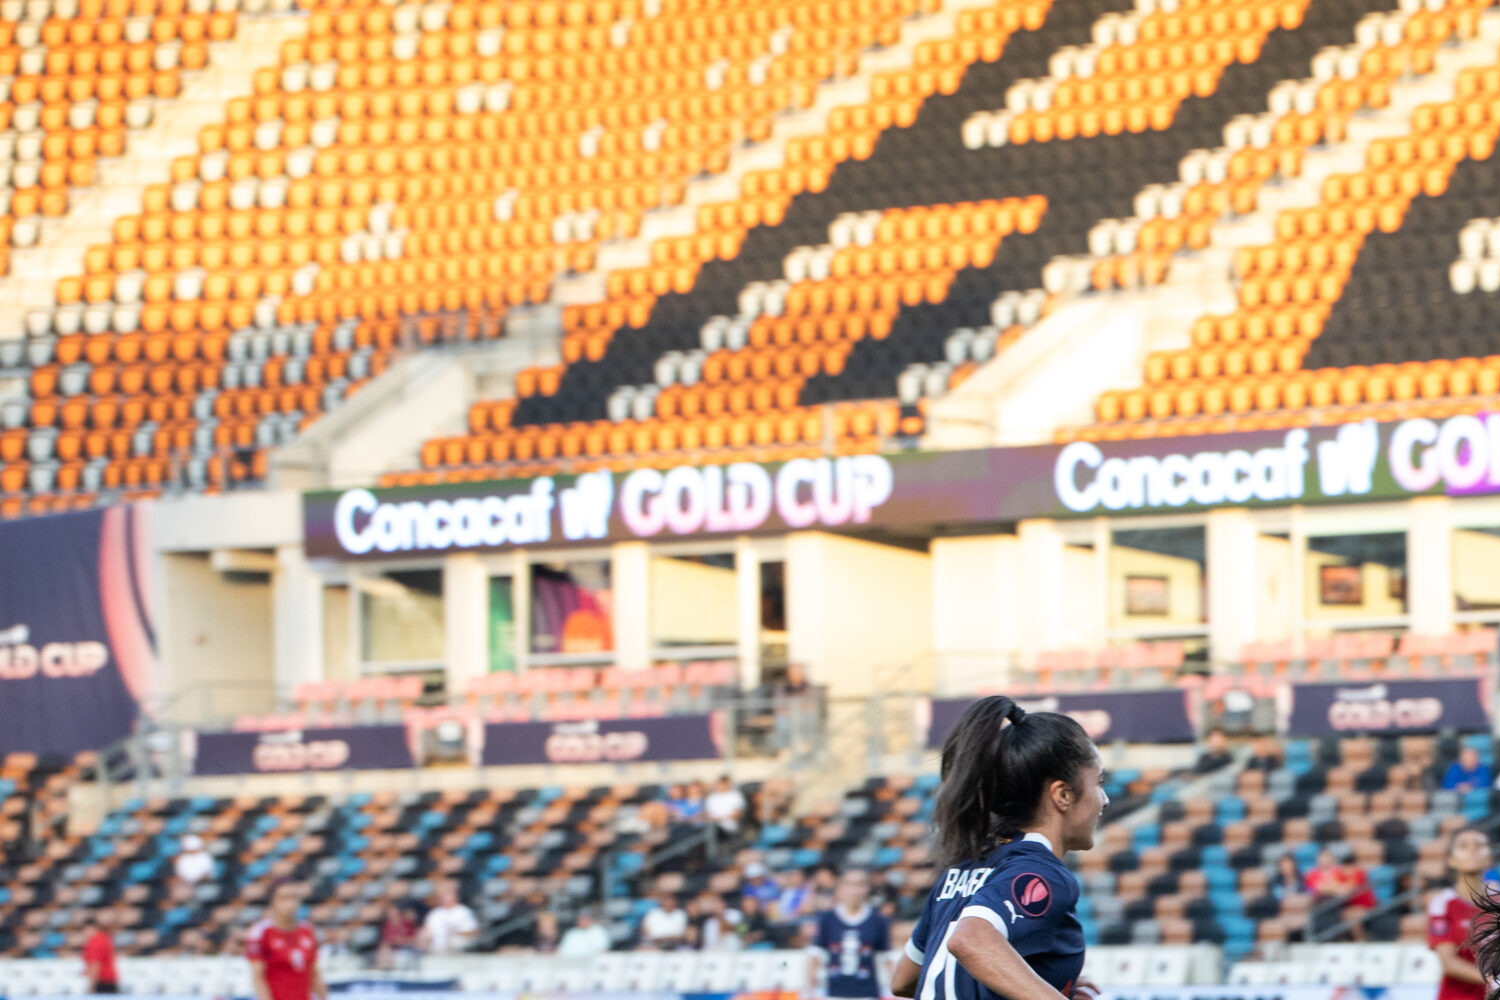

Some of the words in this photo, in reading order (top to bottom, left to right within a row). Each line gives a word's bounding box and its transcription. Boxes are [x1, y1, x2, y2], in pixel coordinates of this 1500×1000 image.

[335, 476, 554, 554] Concacaf
[620, 462, 772, 536] GOLD
[776, 454, 893, 527] CUP
[1055, 428, 1309, 512] Concacaf
